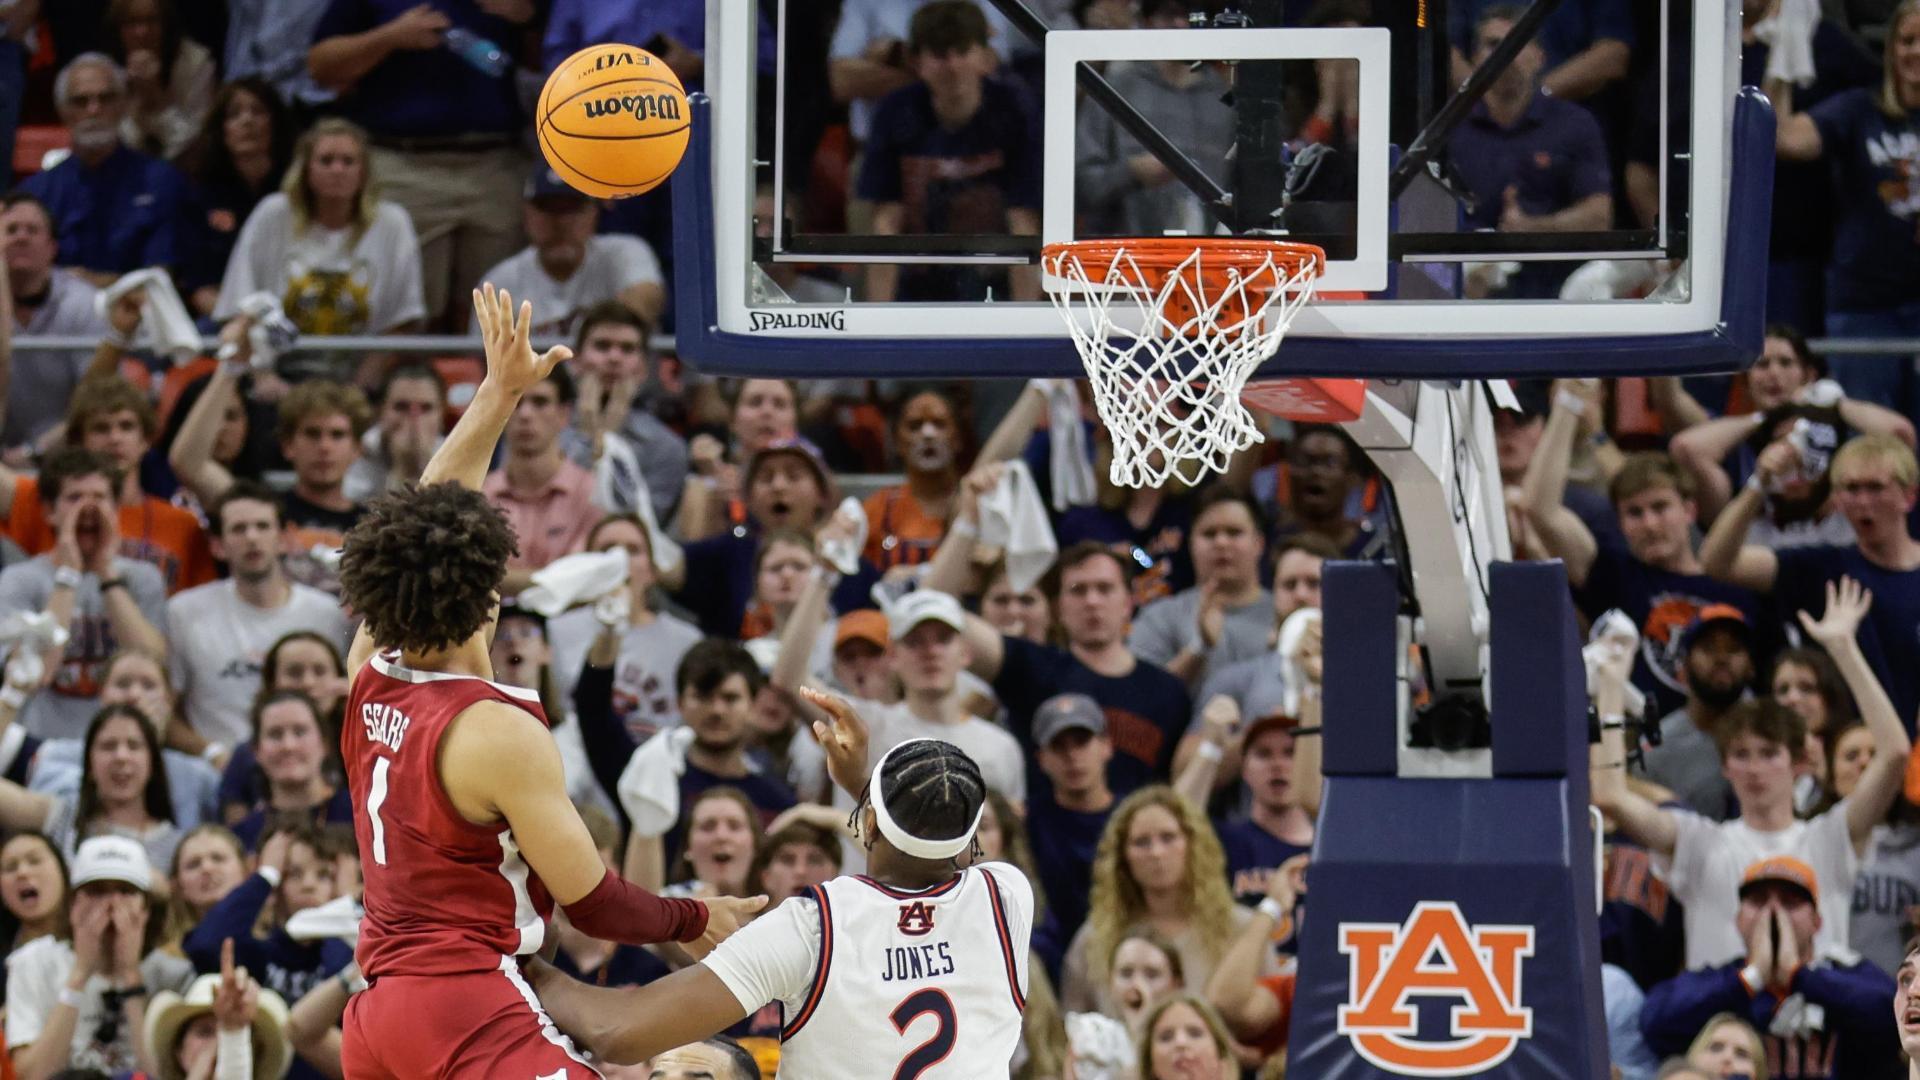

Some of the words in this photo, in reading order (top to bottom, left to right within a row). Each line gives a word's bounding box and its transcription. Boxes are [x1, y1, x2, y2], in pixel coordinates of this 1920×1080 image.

[596, 52, 650, 71] EVO
[583, 94, 680, 121] Wilson
[749, 310, 845, 331] SPALDING
[362, 703, 410, 753] SEARS
[367, 755, 391, 866] 1
[882, 941, 955, 981] JONES
[888, 986, 958, 1080] 2
